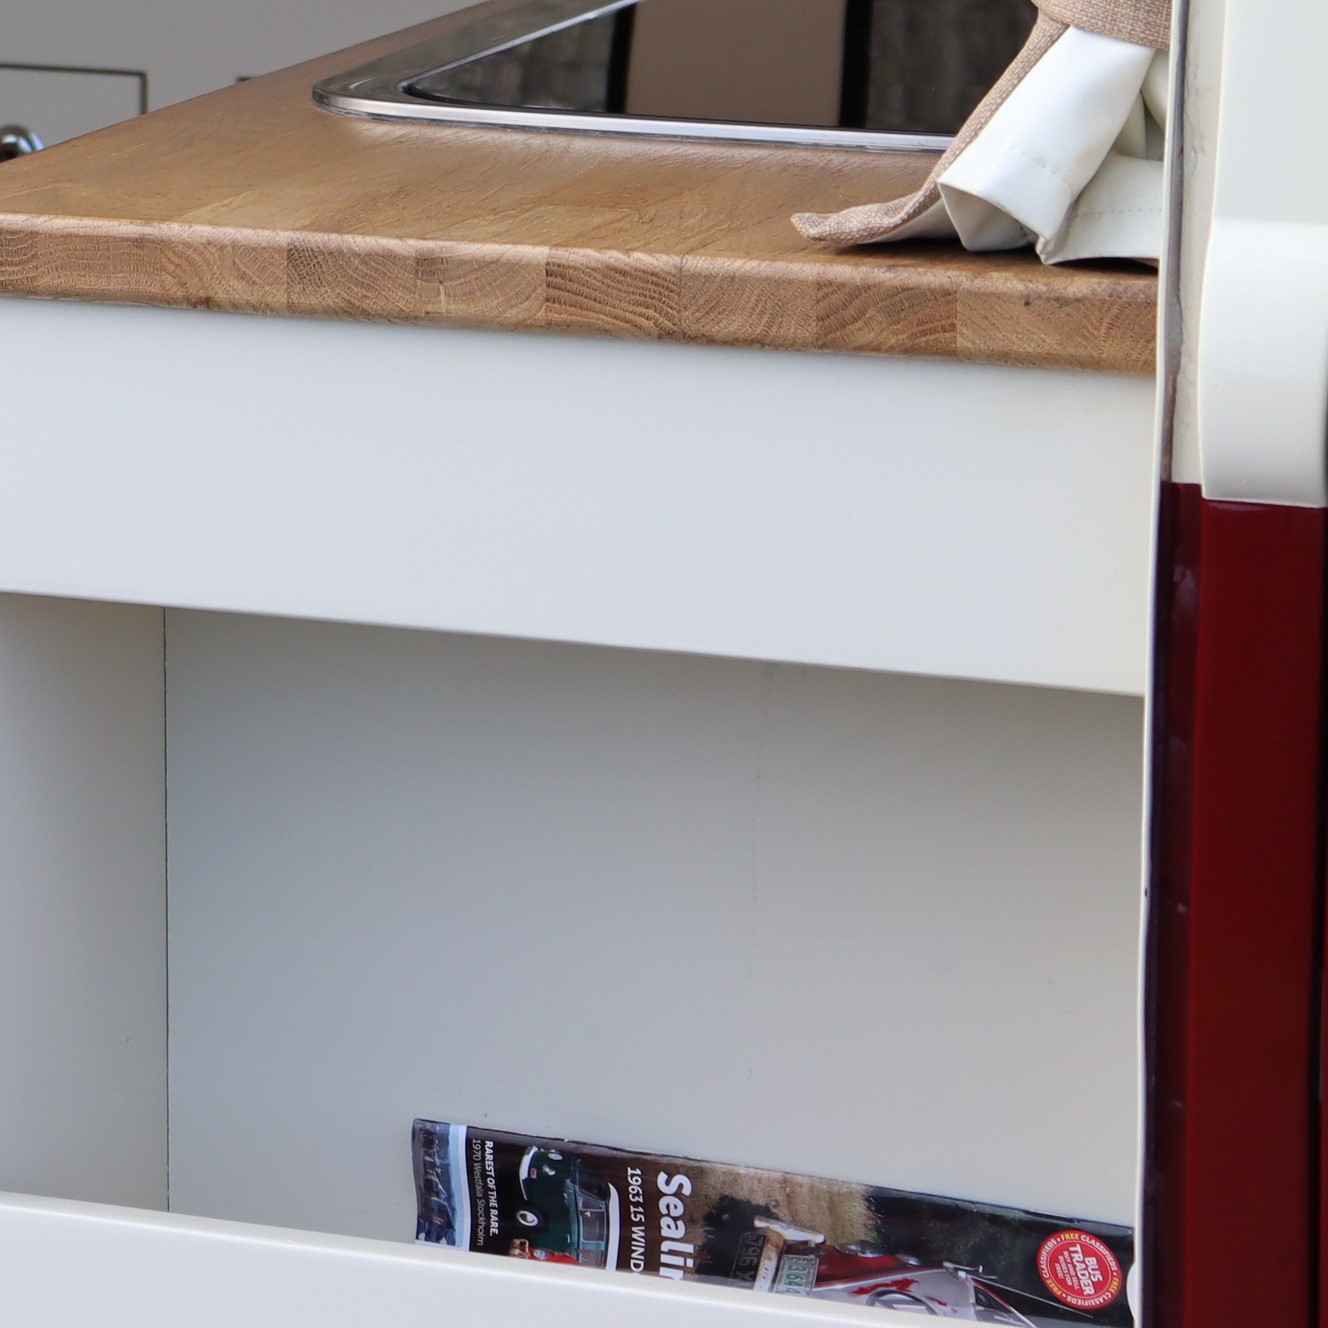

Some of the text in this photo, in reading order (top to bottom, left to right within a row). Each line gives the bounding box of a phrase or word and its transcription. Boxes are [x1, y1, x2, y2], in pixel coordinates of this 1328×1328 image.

[472, 1138, 487, 1246] 1970 Westfalia Stockholm
[484, 1140, 499, 1237] RAREST OF THE RARE.
[627, 1166, 646, 1273] 1963 15 WIND
[1040, 1238, 1063, 1296] FREE CLASSIFIEDS
[1060, 1233, 1118, 1271] FREE CLASSIFIEDS
[1068, 1243, 1095, 1296] TRADER
[1084, 1256, 1104, 1283] BUS
[1066, 1276, 1120, 1307] FREE CLASSIFIEDS
